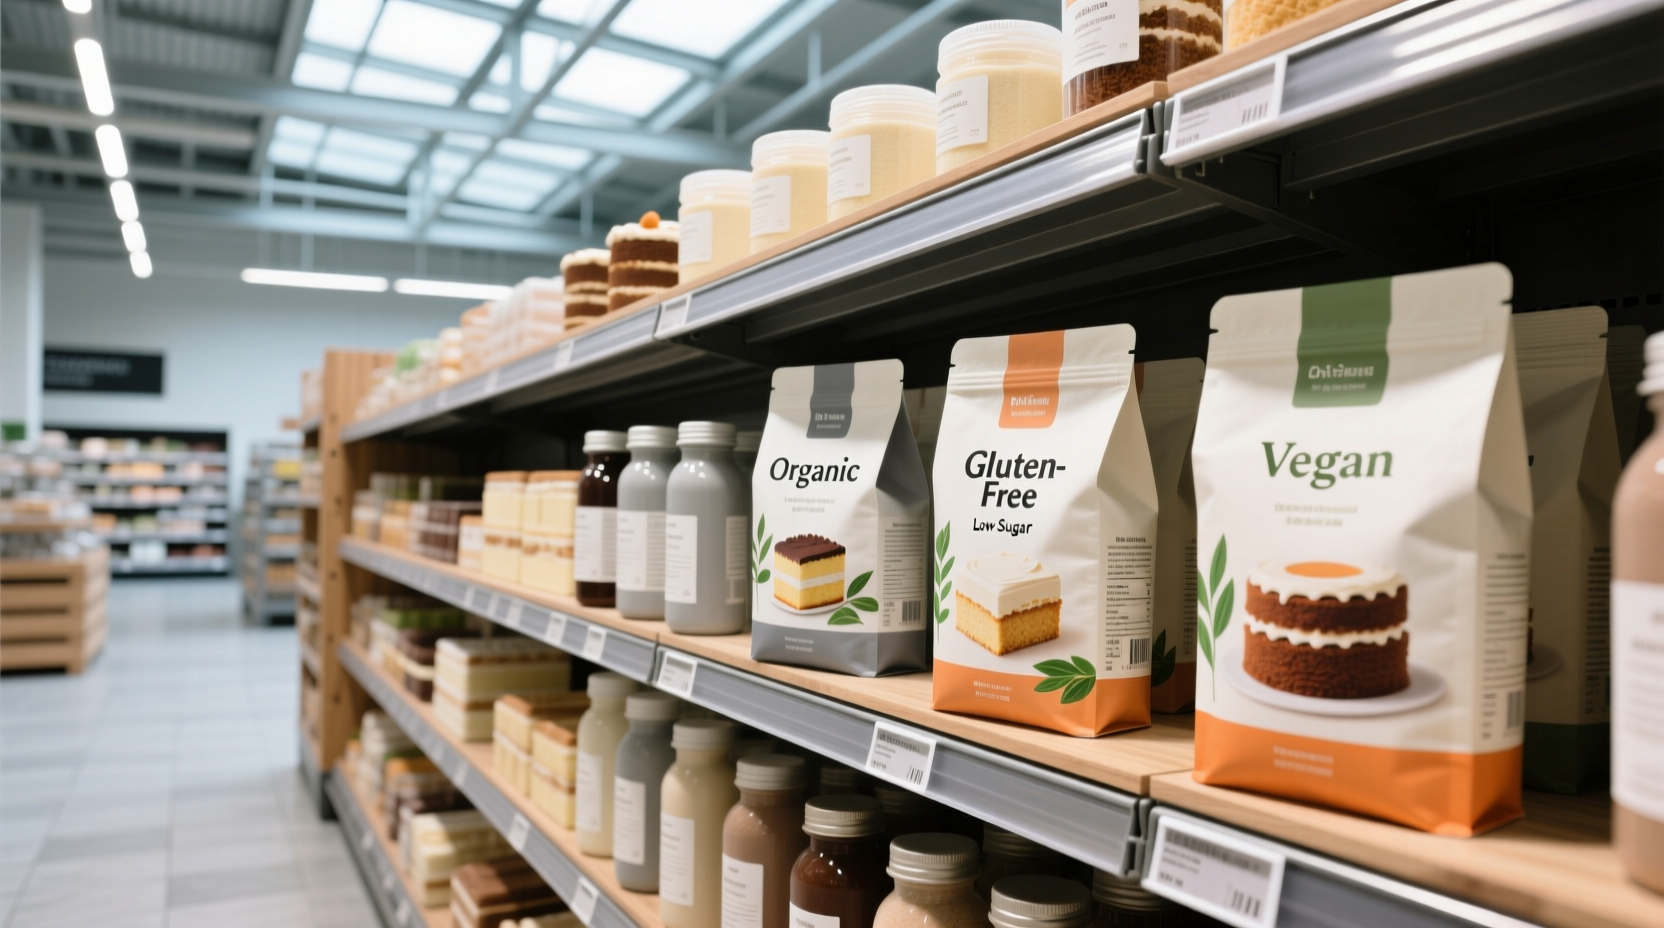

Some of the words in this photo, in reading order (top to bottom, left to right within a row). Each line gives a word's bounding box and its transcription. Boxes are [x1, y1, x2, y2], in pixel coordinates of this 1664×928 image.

[769, 456, 861, 489] Organic
[964, 450, 1066, 481] Gluten-
[1262, 441, 1393, 490] Vegan
[980, 481, 1038, 509] Free
[972, 517, 996, 532] Low
[997, 518, 1033, 537] Sugar
